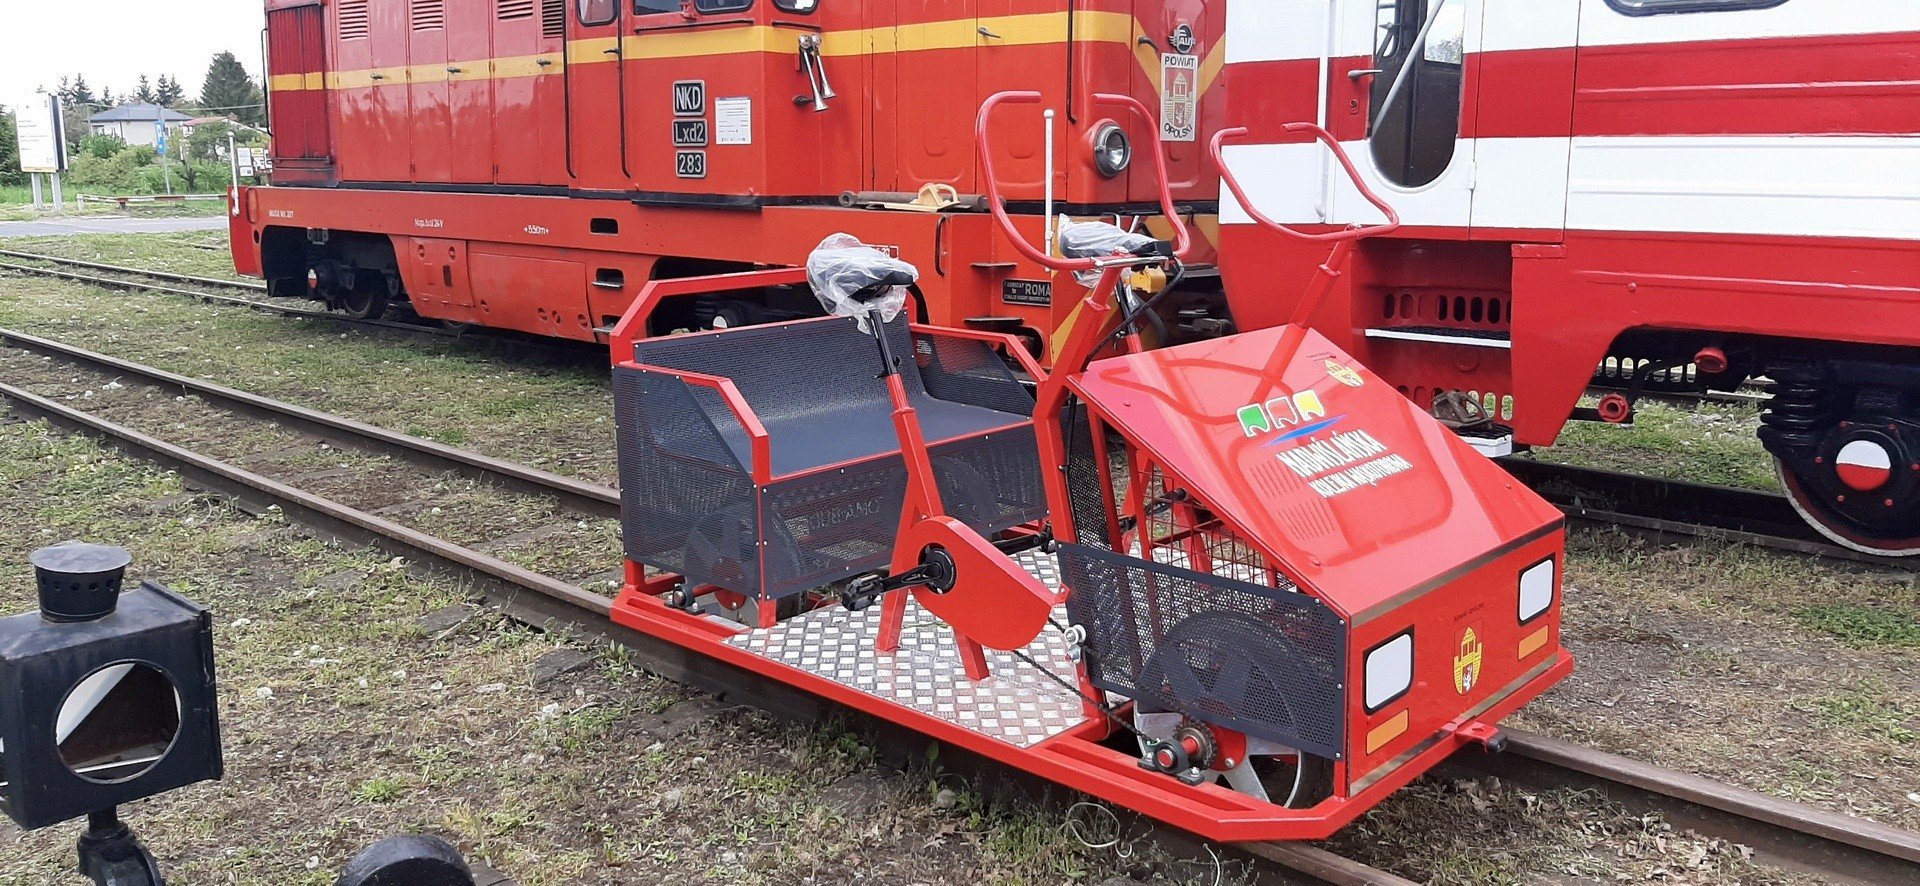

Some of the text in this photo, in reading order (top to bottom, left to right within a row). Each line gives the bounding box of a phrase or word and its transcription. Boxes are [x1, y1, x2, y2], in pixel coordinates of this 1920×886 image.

[1164, 56, 1195, 66] POWIAT
[675, 86, 701, 110] NKD
[675, 123, 704, 142] Lxd2
[1163, 123, 1193, 139] OPOLSKI
[679, 154, 702, 173] 283
